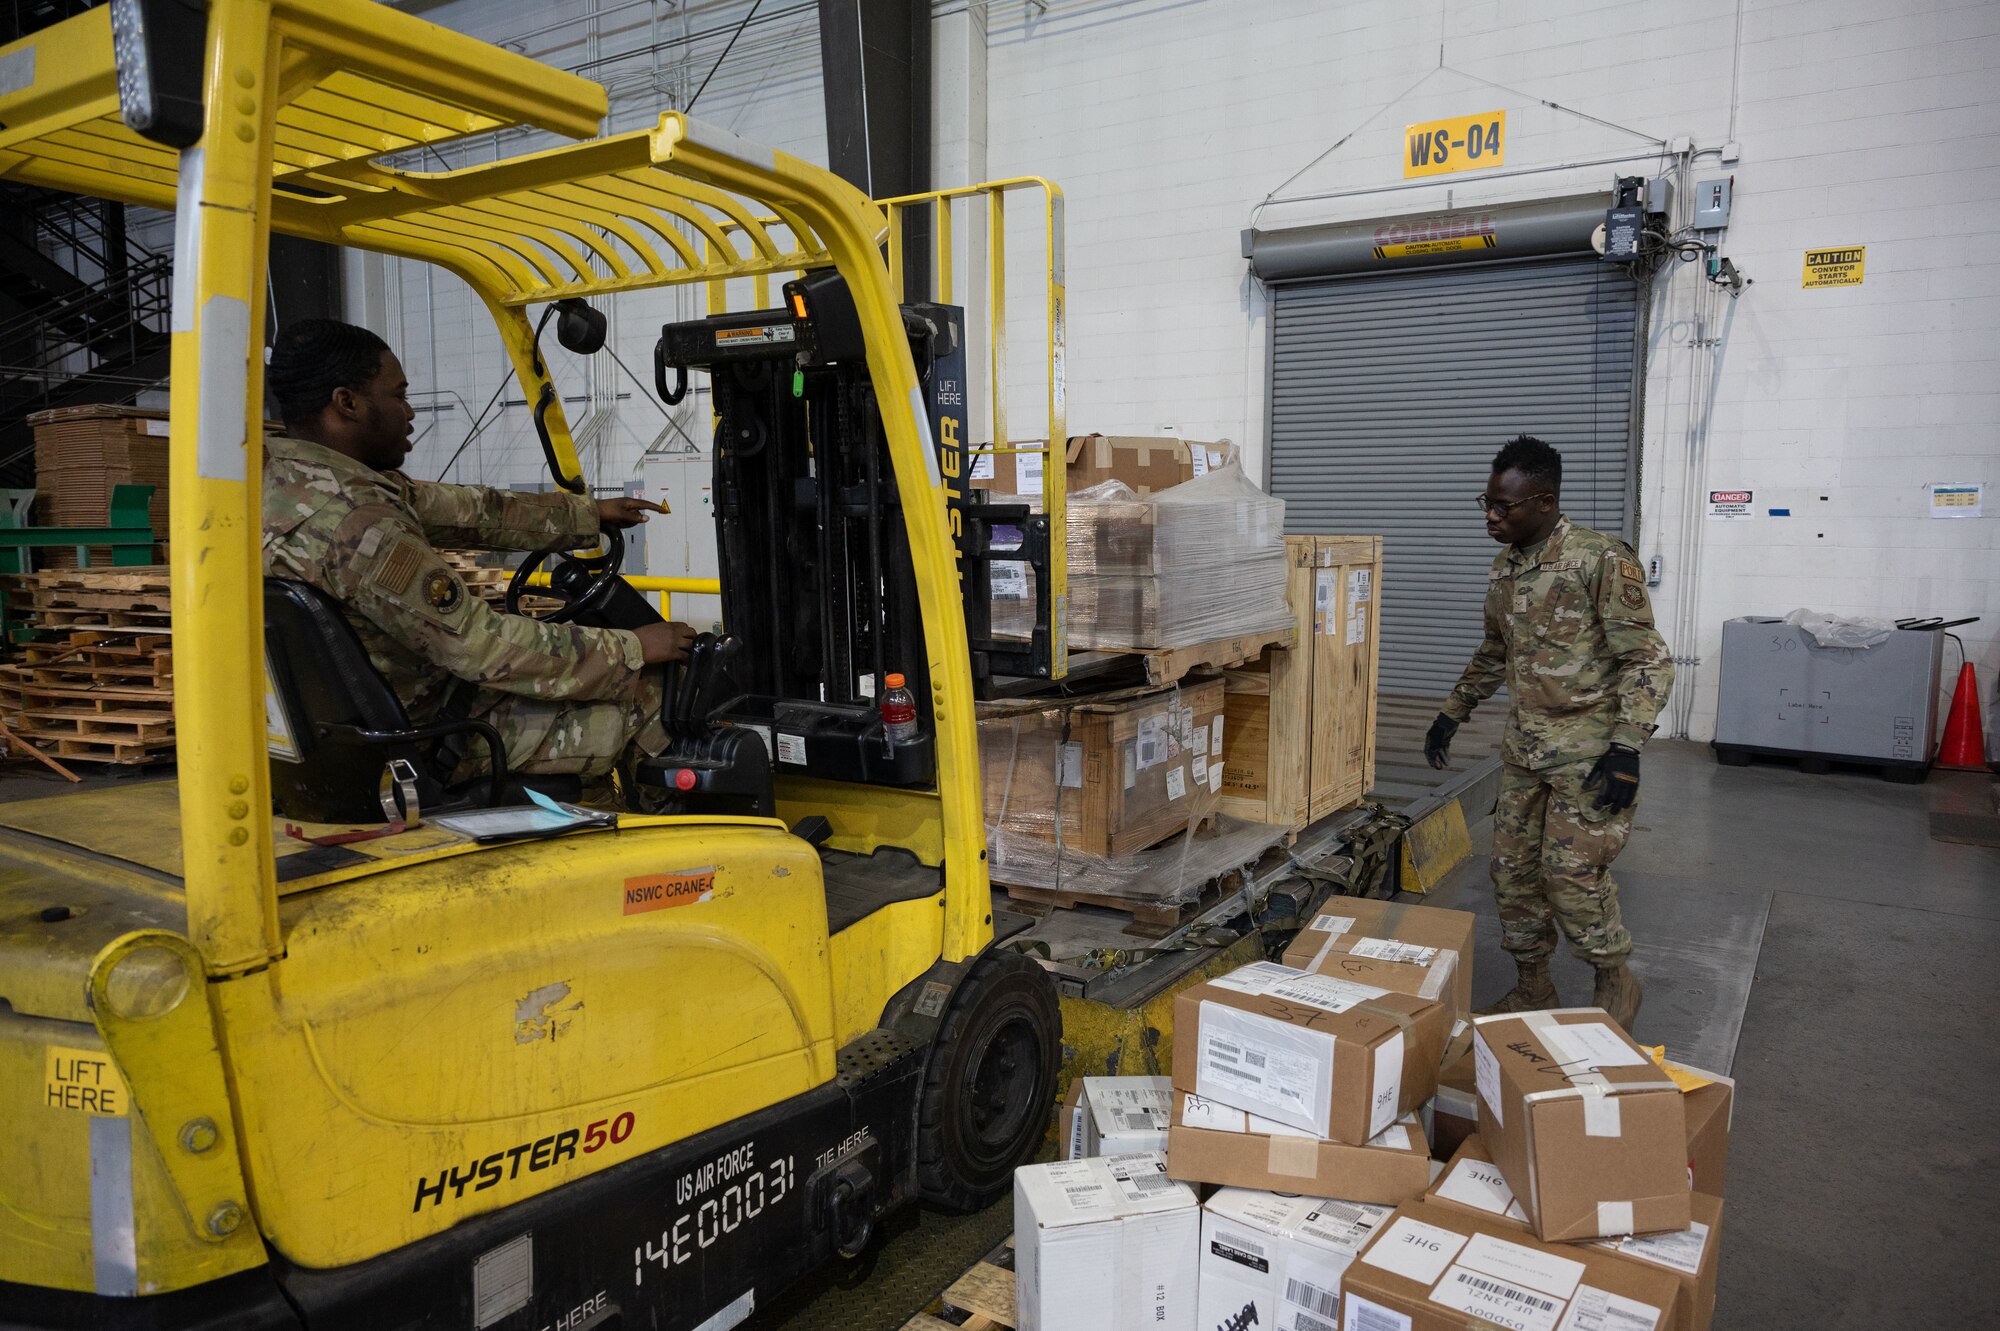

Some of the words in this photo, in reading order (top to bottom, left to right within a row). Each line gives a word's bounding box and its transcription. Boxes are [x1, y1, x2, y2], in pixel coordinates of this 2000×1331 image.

[1409, 121, 1500, 167] WS-04
[1374, 213, 1495, 246] CORNELL
[1405, 242, 1431, 250] CAUTION:
[1808, 250, 1861, 265] CAUTION
[1811, 264, 1855, 274] CONVEYOR
[1818, 272, 1847, 280] STARTS
[1805, 277, 1861, 286] AUTOMATICALLY
[940, 380, 957, 391] LIFT
[937, 392, 961, 405] HERE
[1714, 493, 1748, 501] DANGER
[626, 884, 663, 905] NSWC
[1262, 1000, 1328, 1027] 37
[56, 1057, 106, 1085] LIFT
[48, 1083, 115, 1114] HERE
[1377, 1086, 1393, 1110] 9HE
[815, 1150, 834, 1169] TIE
[836, 1125, 870, 1158] HERE
[412, 1128, 580, 1214] HYSTER
[583, 1111, 636, 1154] 50
[676, 1173, 693, 1205] US
[694, 1163, 715, 1197] AIR
[717, 1141, 754, 1186] FORCE
[1467, 1170, 1505, 1186] 9HE
[635, 1155, 794, 1286] 14E00031
[1402, 1233, 1442, 1252] 9HE
[1156, 1284, 1165, 1301] #12
[1467, 1287, 1534, 1316] UFJ3NZL
[556, 1290, 607, 1331] HERE
[1156, 1305, 1165, 1322] BOX
